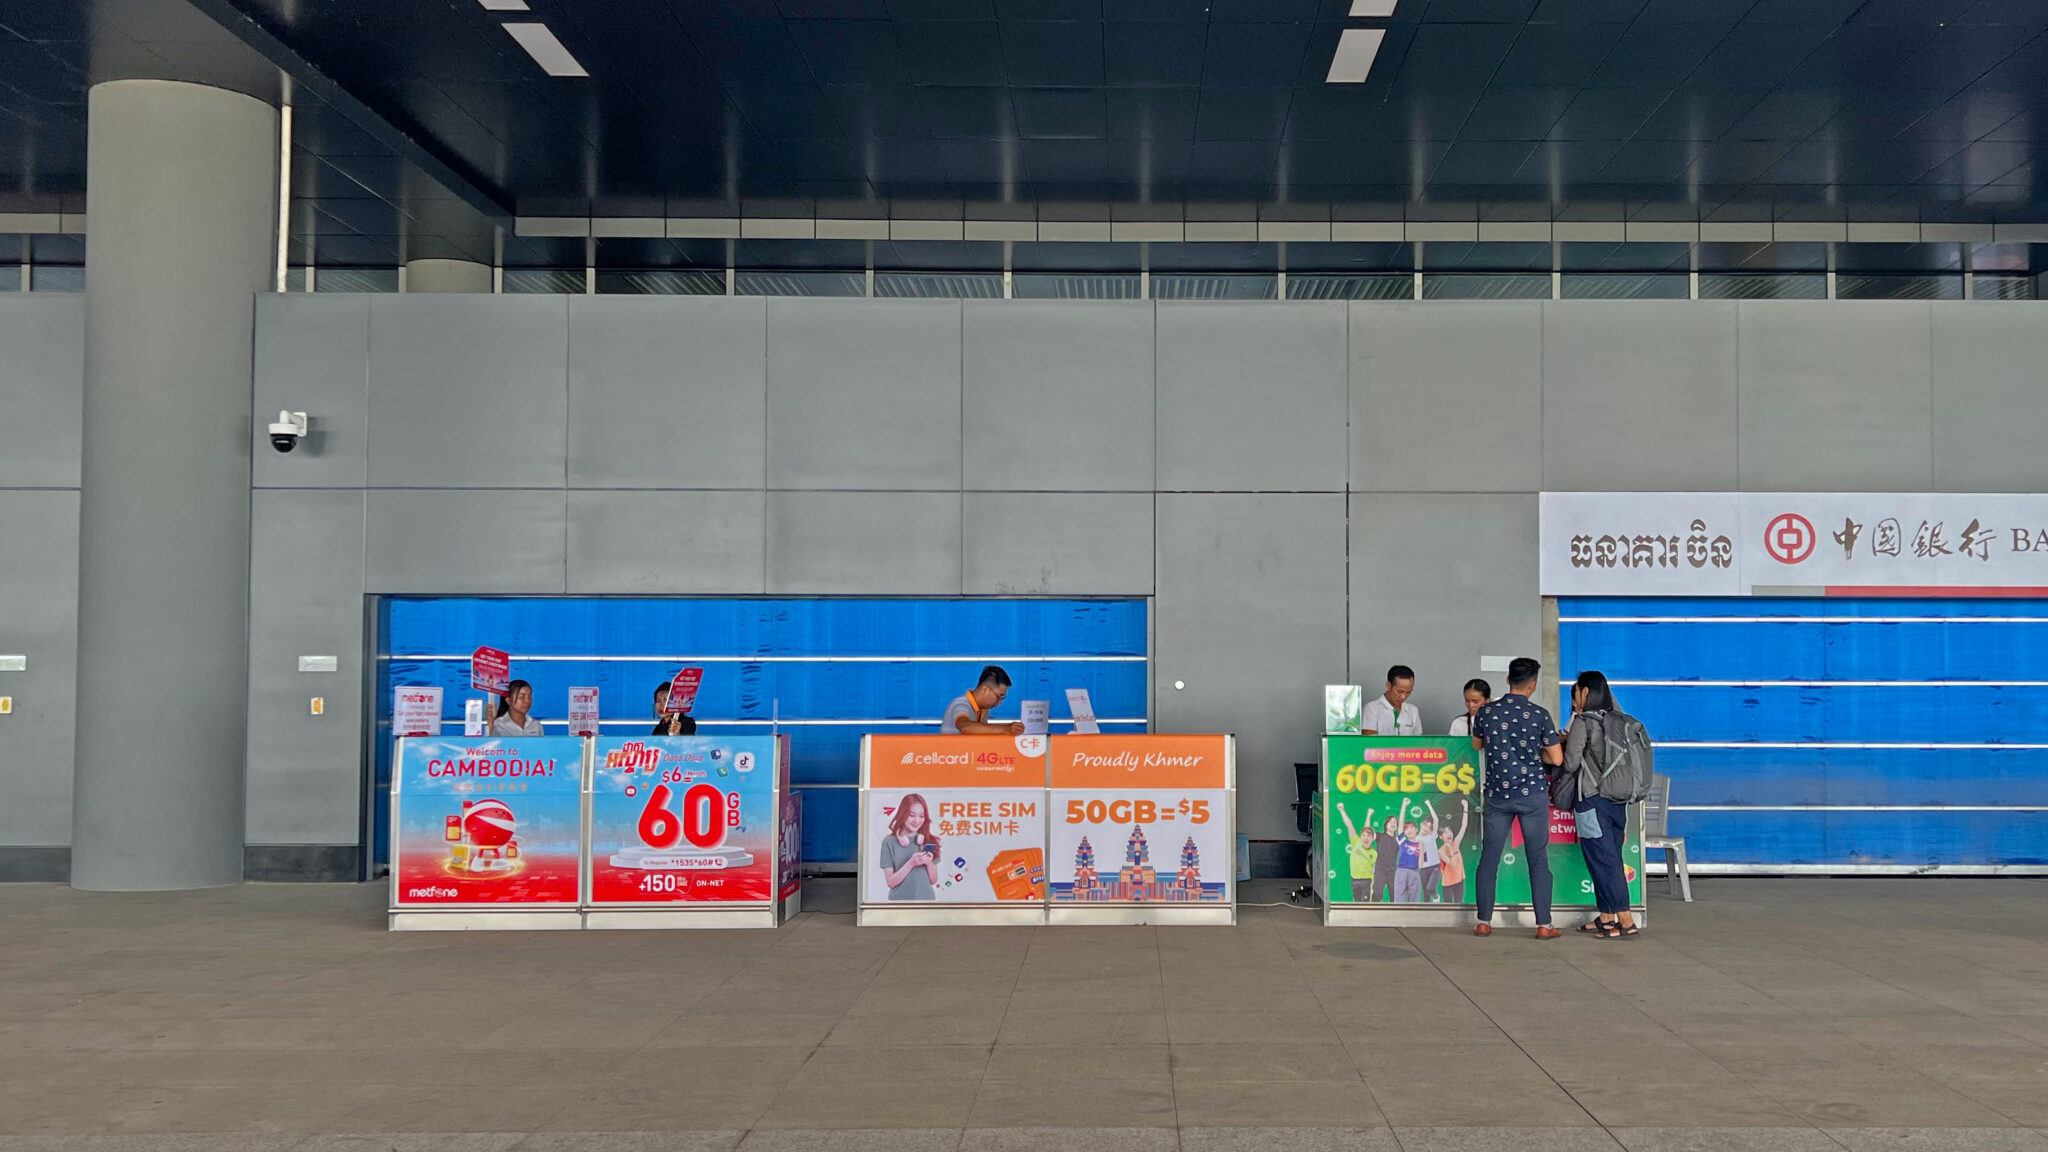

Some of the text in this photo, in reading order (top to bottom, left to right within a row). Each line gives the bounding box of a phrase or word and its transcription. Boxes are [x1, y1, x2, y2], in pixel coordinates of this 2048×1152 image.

[466, 748, 518, 756] Welcom to
[915, 752, 969, 765] cellcard
[977, 752, 998, 765] 4G
[1371, 750, 1443, 760] Enjoy more data
[1072, 750, 1203, 772] Proudly Khmer
[428, 759, 554, 777] CAMBODIA!
[939, 802, 1036, 817] FREE SIM
[638, 784, 724, 850] 60
[1549, 823, 1576, 833] etw
[639, 874, 676, 892] +150
[409, 886, 458, 898] metfone
